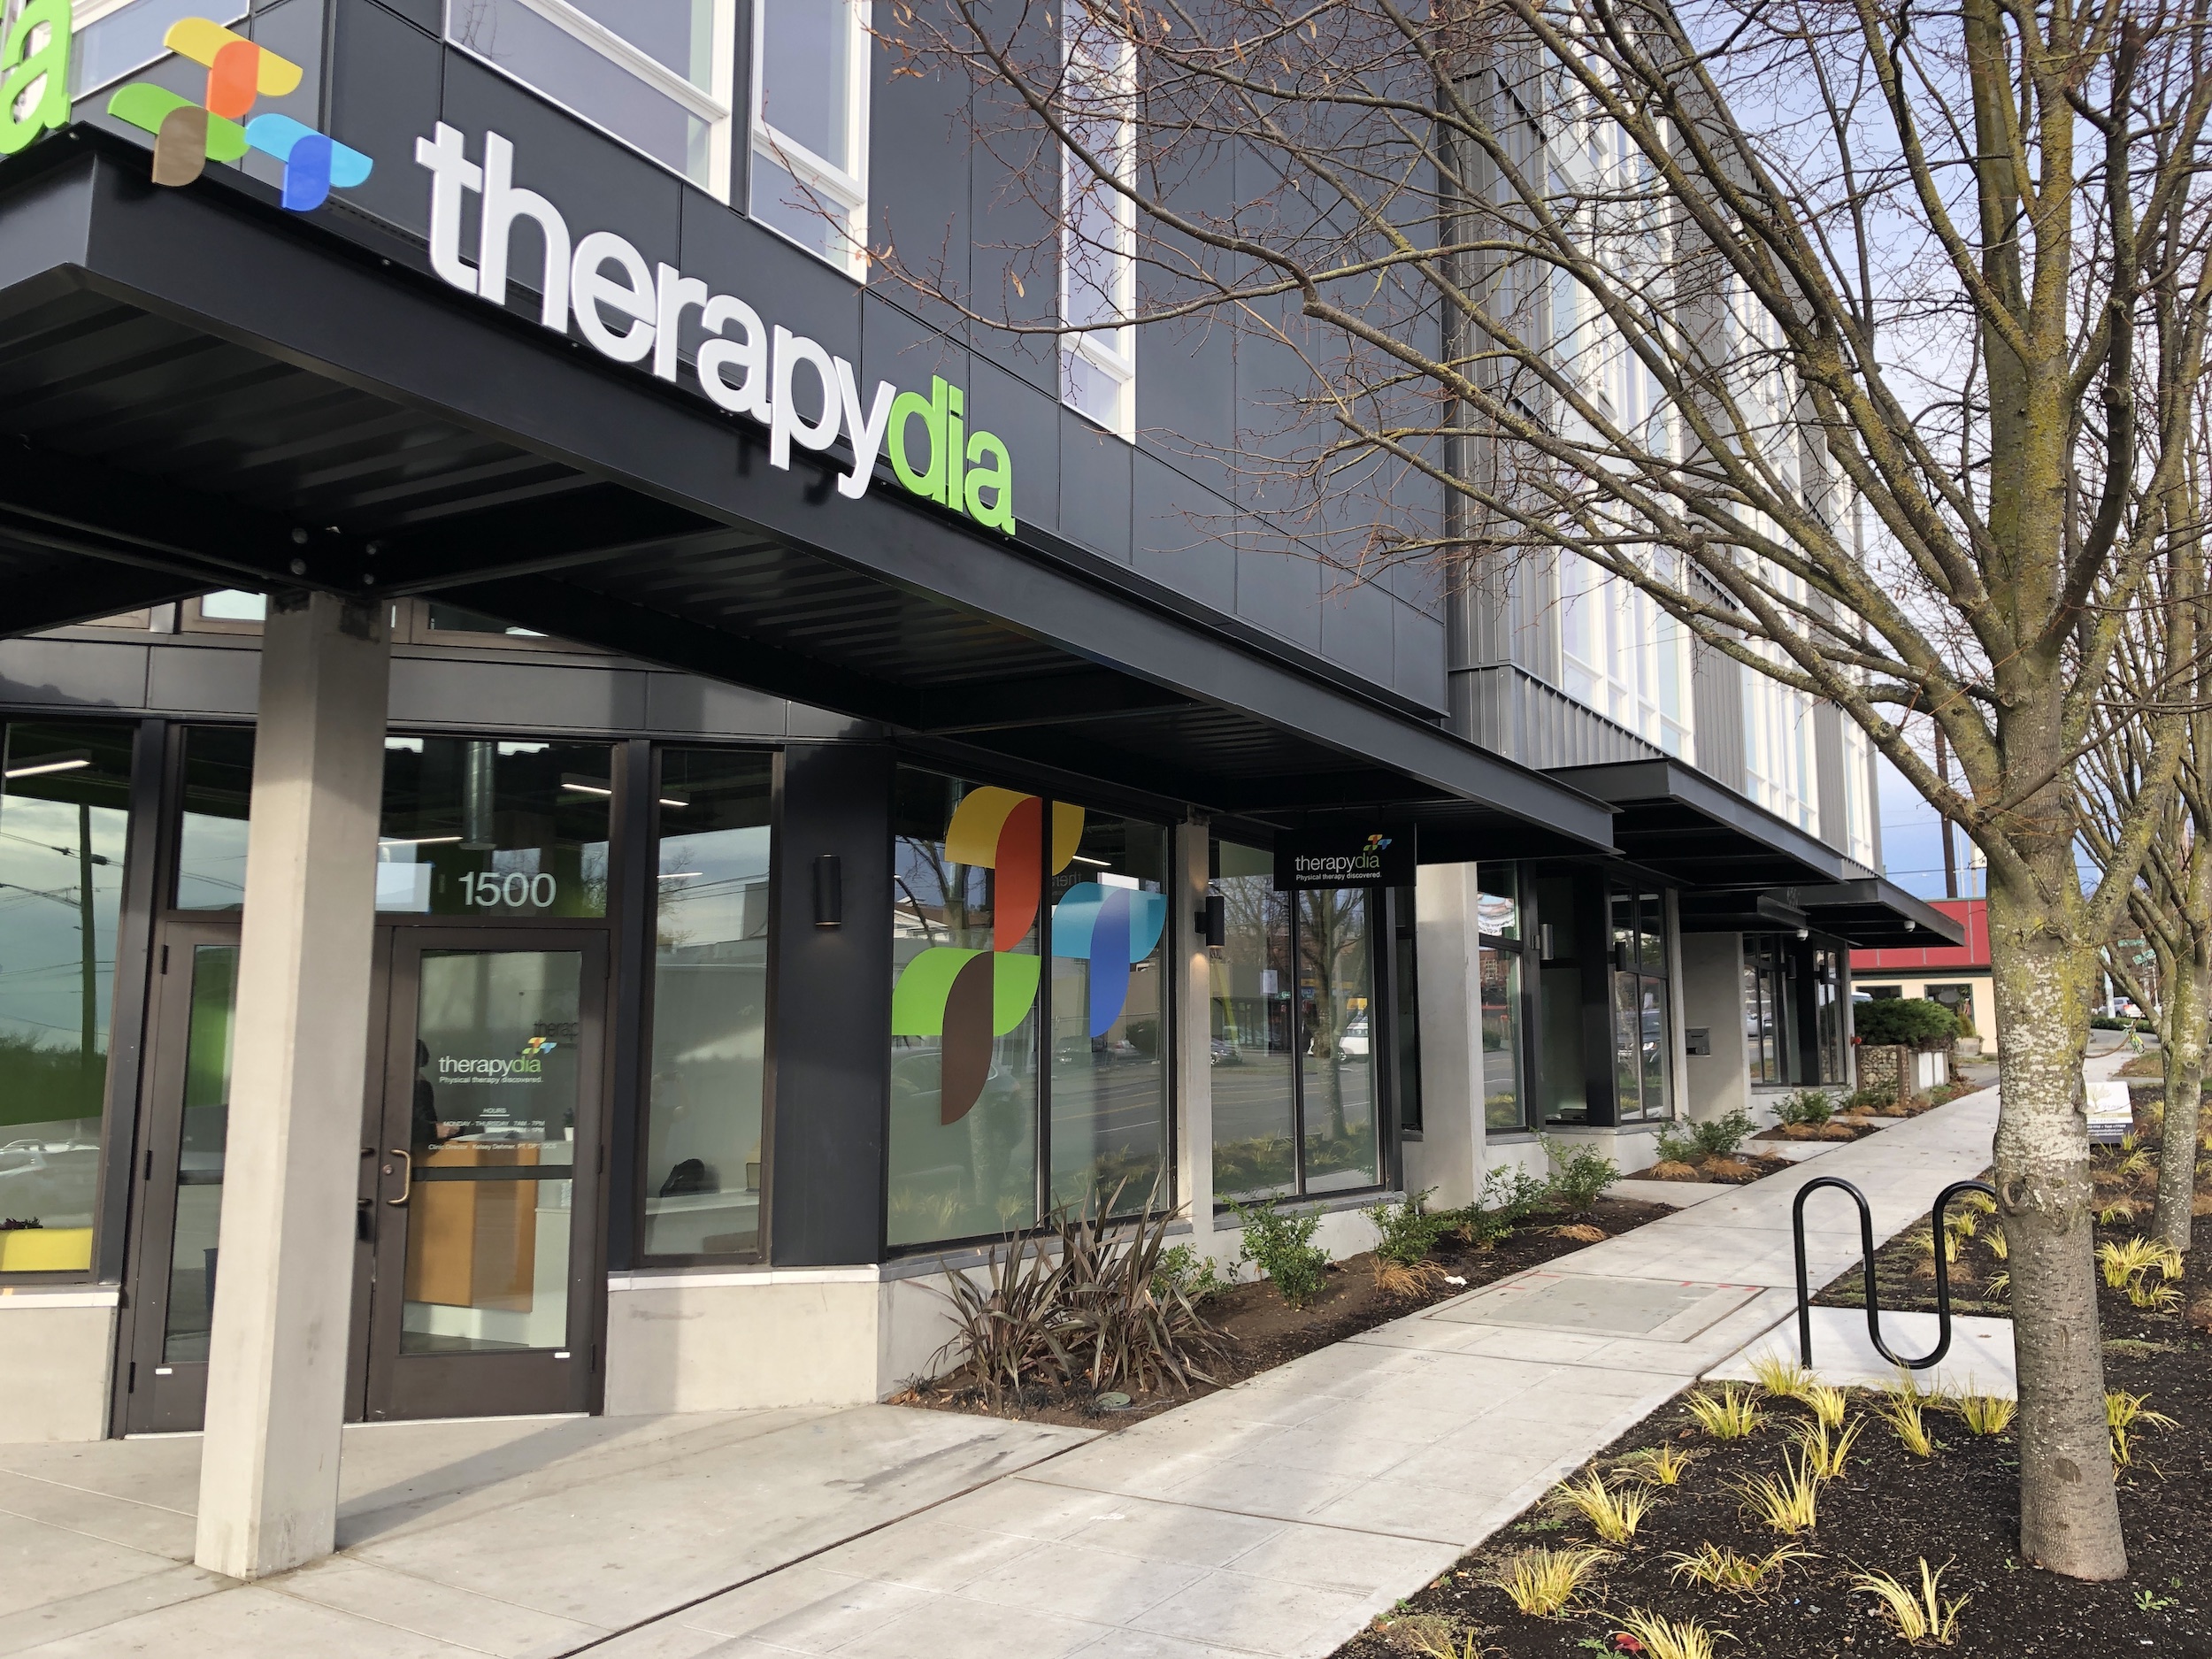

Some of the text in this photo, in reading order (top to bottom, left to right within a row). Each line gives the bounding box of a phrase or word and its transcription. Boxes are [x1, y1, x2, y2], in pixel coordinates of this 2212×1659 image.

[415, 120, 1016, 536] therapydia
[1295, 852, 1380, 873] therapydia
[457, 871, 557, 908] 1500
[439, 1055, 542, 1077] therapydia
[439, 1076, 471, 1085] Physical
